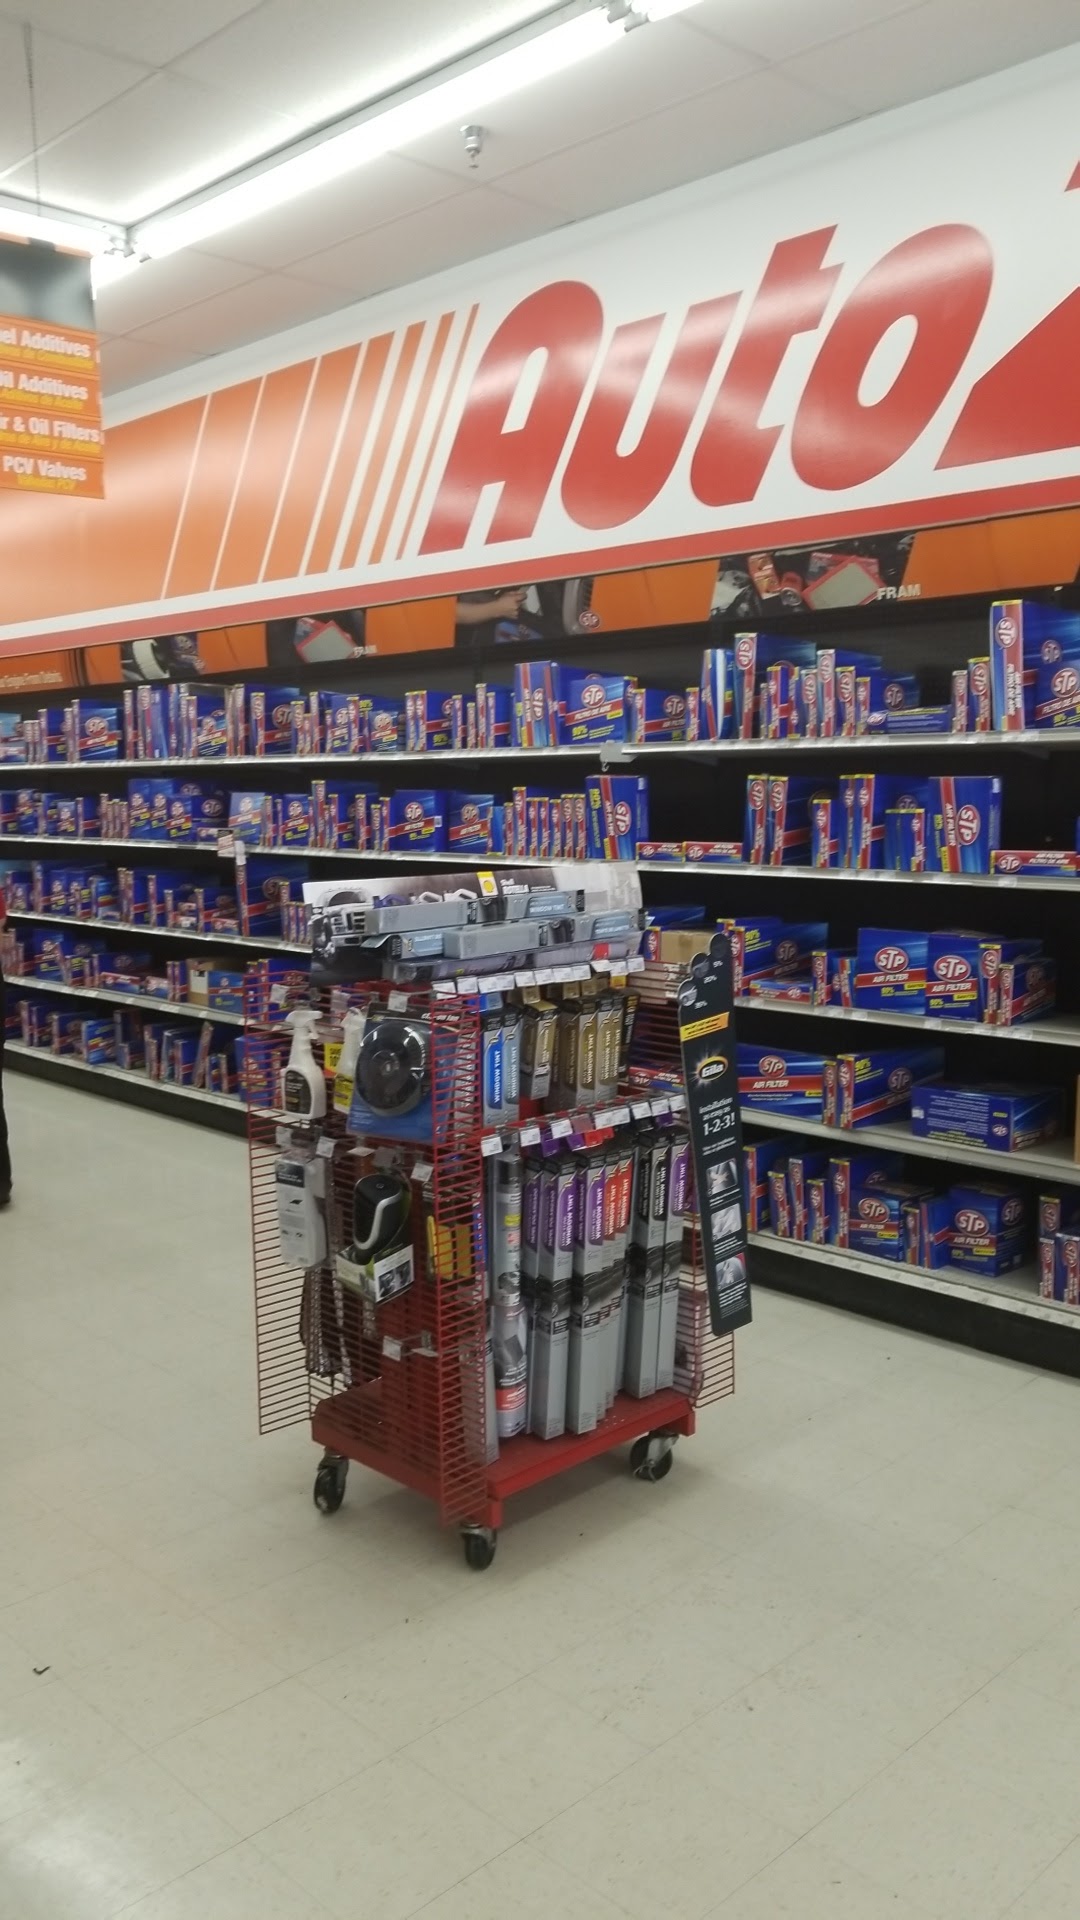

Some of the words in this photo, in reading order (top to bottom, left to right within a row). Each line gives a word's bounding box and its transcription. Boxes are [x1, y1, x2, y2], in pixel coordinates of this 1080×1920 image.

[21, 330, 91, 358] Additives
[18, 374, 88, 400] Additives
[13, 416, 25, 432] &
[28, 417, 49, 435] Oil
[53, 420, 100, 443] Filters
[2, 455, 34, 475] PCV
[37, 459, 87, 481] Valves
[876, 584, 921, 600] FRAM
[999, 619, 1016, 645] STP
[739, 643, 751, 664] STP
[1053, 672, 1077, 694] STP
[533, 690, 544, 718] STP
[584, 688, 603, 704] STP
[886, 687, 903, 706] STP
[665, 699, 685, 715] STP
[752, 783, 763, 806] STP
[772, 784, 783, 807] STP
[202, 800, 221, 814] STP
[406, 804, 422, 819] STP
[945, 802, 953, 818] AIR
[615, 805, 629, 833] STP
[958, 809, 977, 841] STP
[946, 819, 956, 847] FILTER
[1000, 857, 1019, 871] STP
[779, 944, 796, 961] STP
[877, 950, 905, 968] STP
[713, 960, 724, 968] 5%
[938, 958, 967, 978] STP
[984, 952, 997, 977] STP
[872, 975, 886, 983] AIR
[886, 973, 909, 982] FILTER
[931, 984, 945, 993] AIR
[946, 982, 972, 991] FILTER
[510, 1046, 518, 1063] TINT
[701, 1063, 724, 1079] Gila
[762, 1058, 782, 1074] STP
[752, 1081, 765, 1089] AIR
[765, 1080, 789, 1088] FILTER
[891, 1071, 910, 1088] STP
[703, 1111, 736, 1136] 1-2-3!
[566, 1194, 574, 1211] TINT
[658, 1183, 666, 1216] WINDOW
[619, 1195, 627, 1228] WINDOW
[864, 1202, 885, 1218] STP
[1004, 1201, 1021, 1223] STP
[1043, 1206, 1056, 1230] STP
[565, 1211, 573, 1246] WINDOW
[959, 1213, 985, 1231] STP
[965, 1237, 990, 1246] FILTER
[1065, 1242, 1078, 1265] STP
